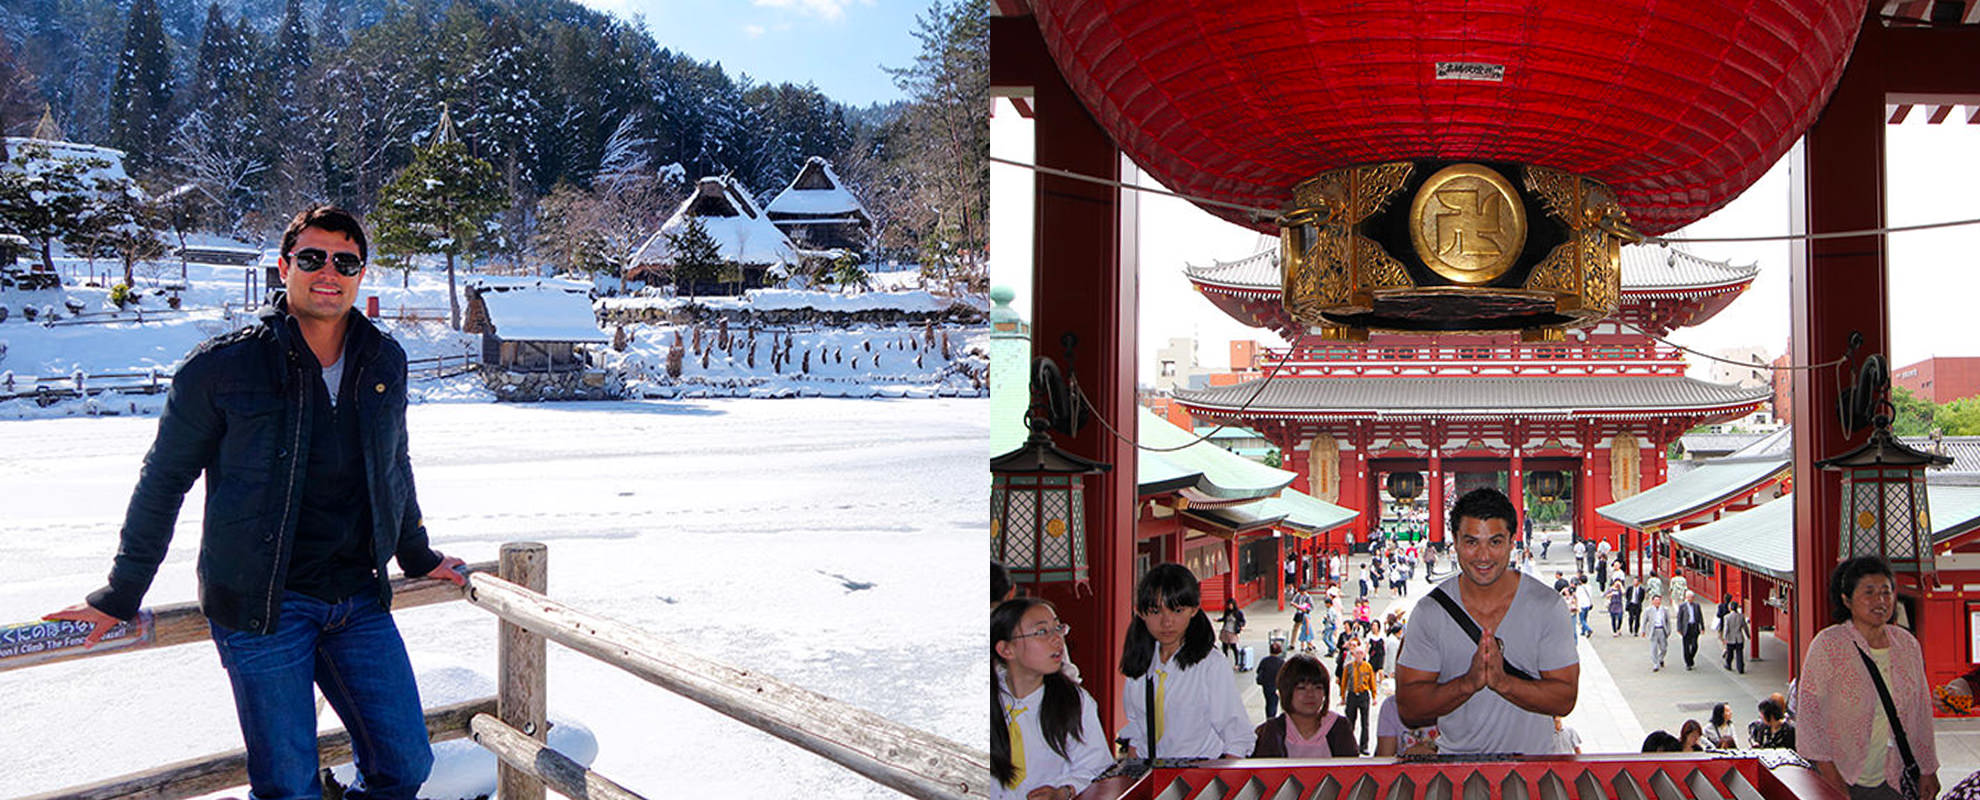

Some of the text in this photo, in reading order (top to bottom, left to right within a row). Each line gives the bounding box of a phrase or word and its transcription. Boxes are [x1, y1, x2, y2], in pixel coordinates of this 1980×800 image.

[20, 641, 44, 653] Climb
[47, 639, 63, 649] The
[64, 636, 86, 647] Fenc
